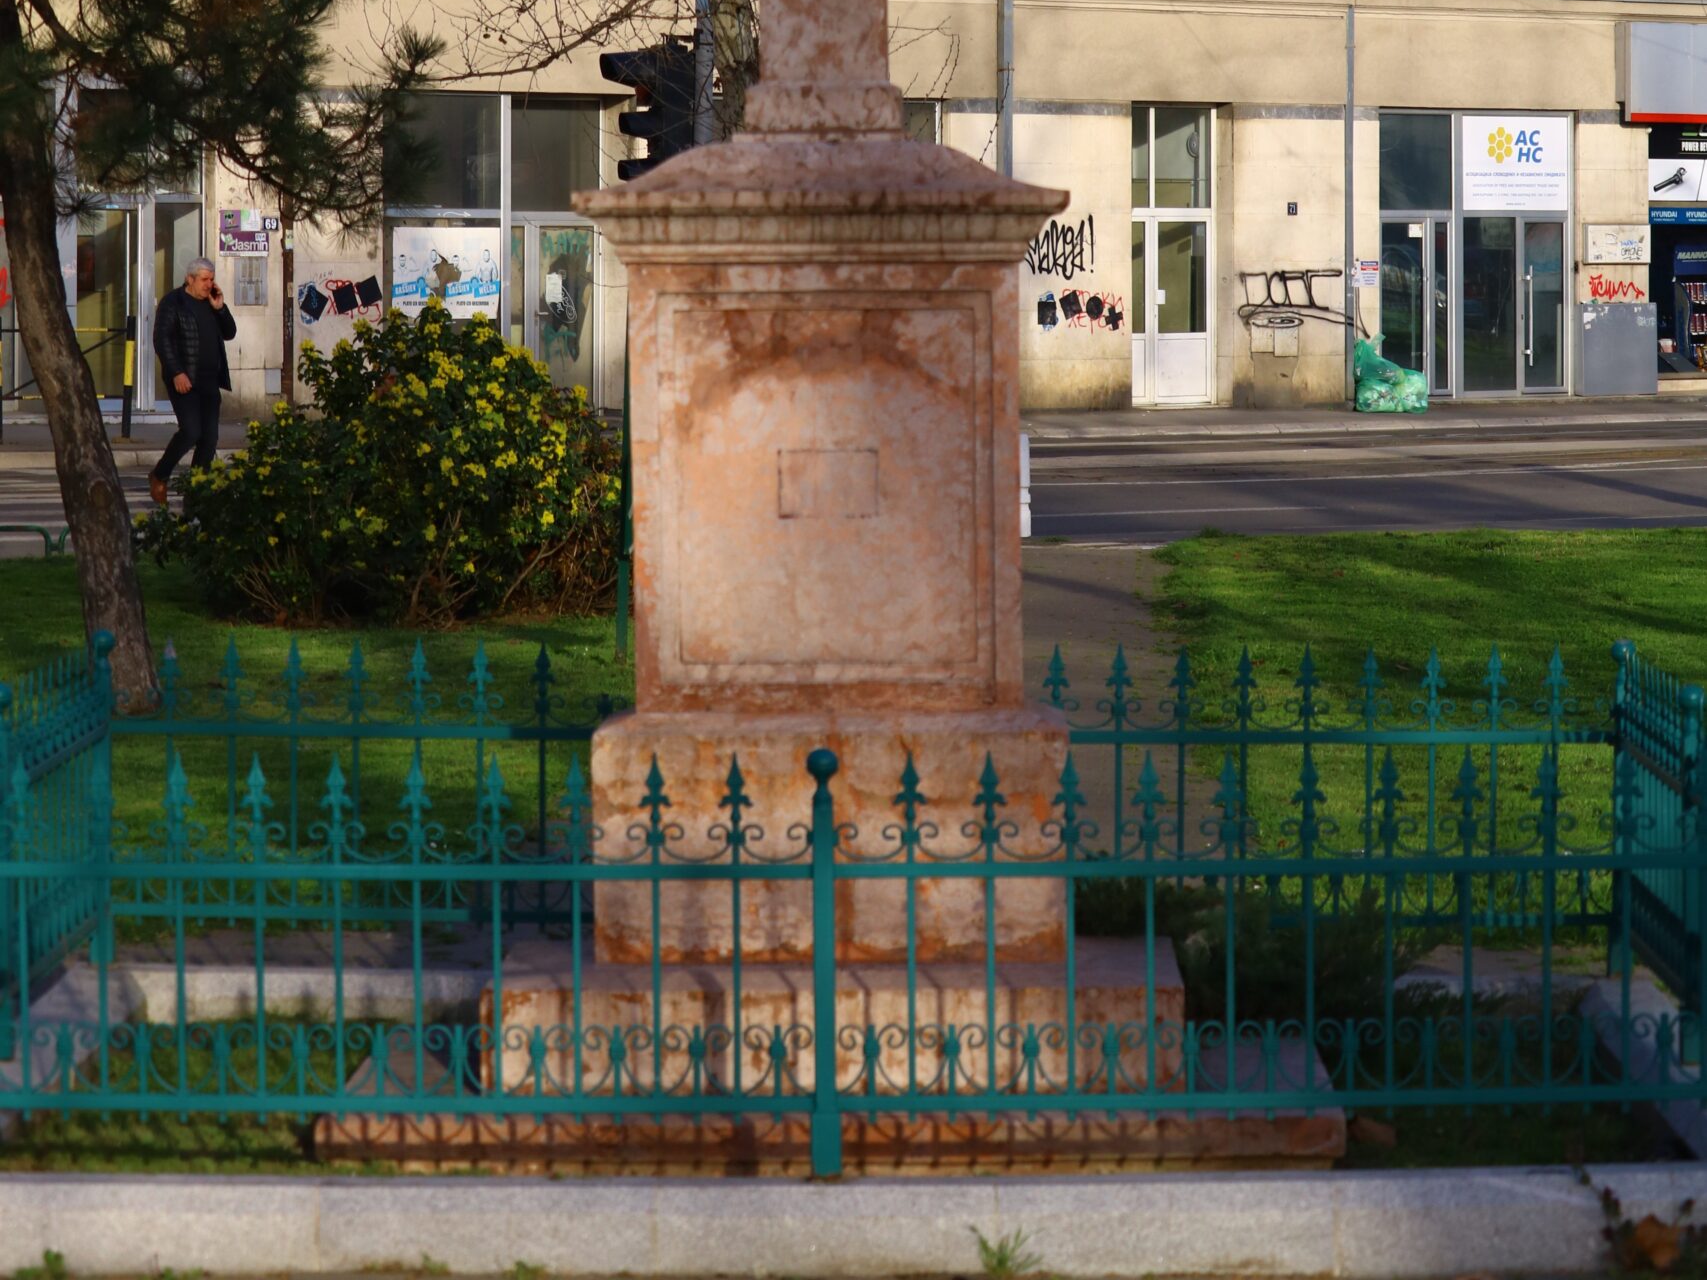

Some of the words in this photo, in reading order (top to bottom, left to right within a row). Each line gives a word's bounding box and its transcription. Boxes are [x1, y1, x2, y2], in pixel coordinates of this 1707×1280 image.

[1681, 141, 1699, 152] POWER
[264, 218, 277, 230] 69
[231, 238, 268, 251] Jasmin
